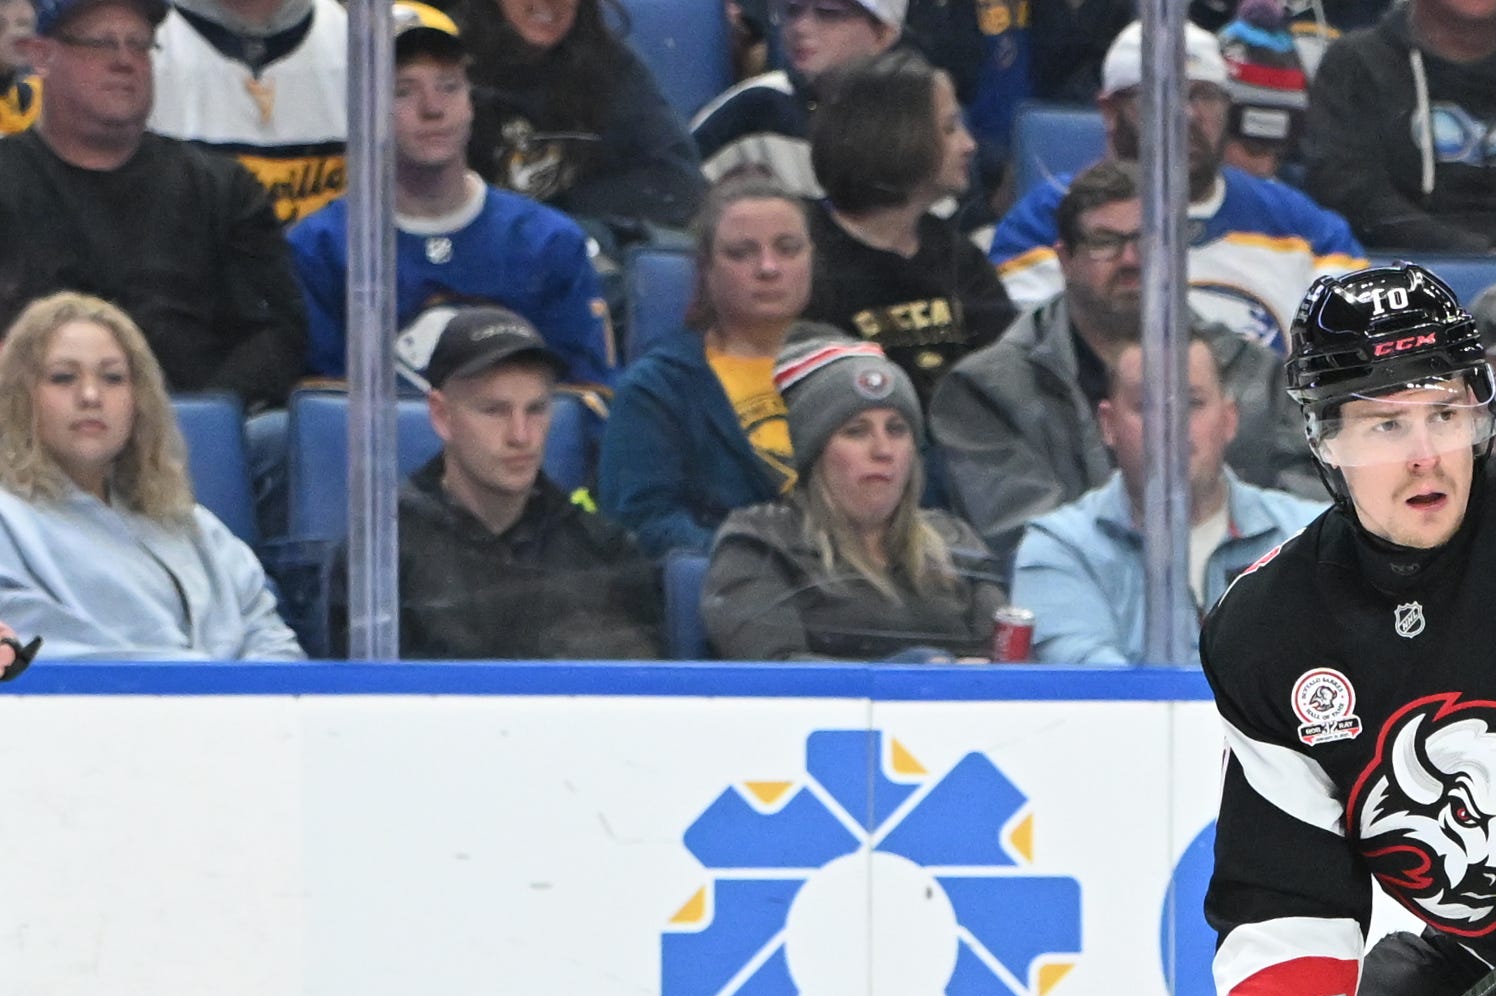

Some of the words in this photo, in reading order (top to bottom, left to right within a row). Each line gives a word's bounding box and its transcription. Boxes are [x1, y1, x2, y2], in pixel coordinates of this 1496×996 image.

[1371, 286, 1409, 316] 10
[1373, 332, 1437, 357] CCM
[1338, 720, 1353, 729] RAY
